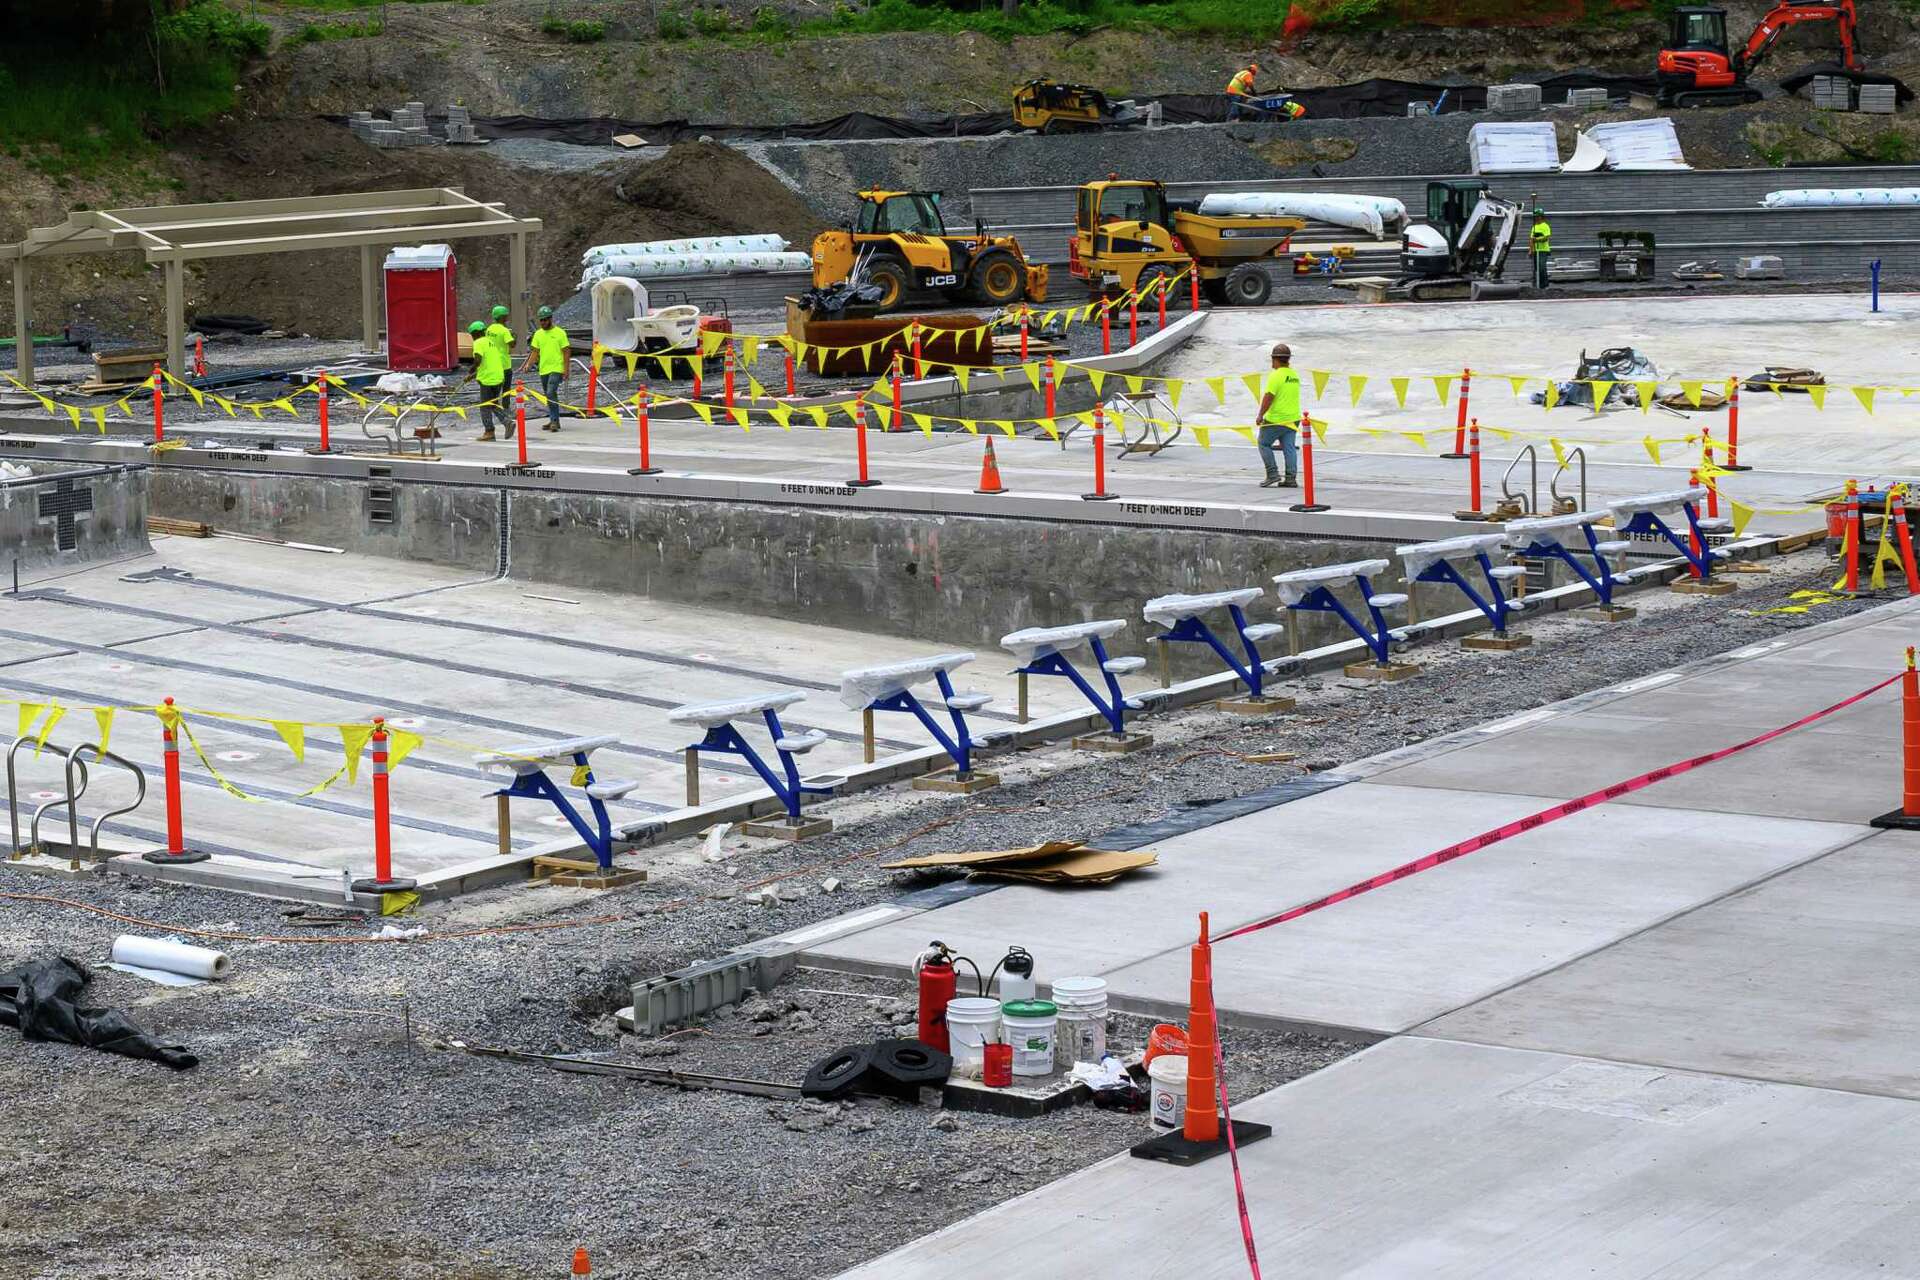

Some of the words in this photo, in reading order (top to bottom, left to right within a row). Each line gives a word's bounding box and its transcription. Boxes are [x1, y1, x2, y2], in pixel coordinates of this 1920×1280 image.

[926, 274, 957, 287] JCB
[214, 452, 229, 460] FEET
[251, 454, 269, 462] DEEP
[518, 468, 535, 478] INCH
[537, 470, 556, 479] DEEP
[781, 484, 787, 493] 6
[788, 484, 807, 494] FEET
[816, 486, 835, 496] INCH
[837, 487, 857, 497] DEEP
[1119, 503, 1125, 513] 7
[1127, 503, 1149, 514] FEET
[1184, 506, 1207, 517] DEEP
[1625, 533, 1631, 541] 8
[1633, 533, 1658, 543] FEET
[1706, 536, 1726, 546] EEP
